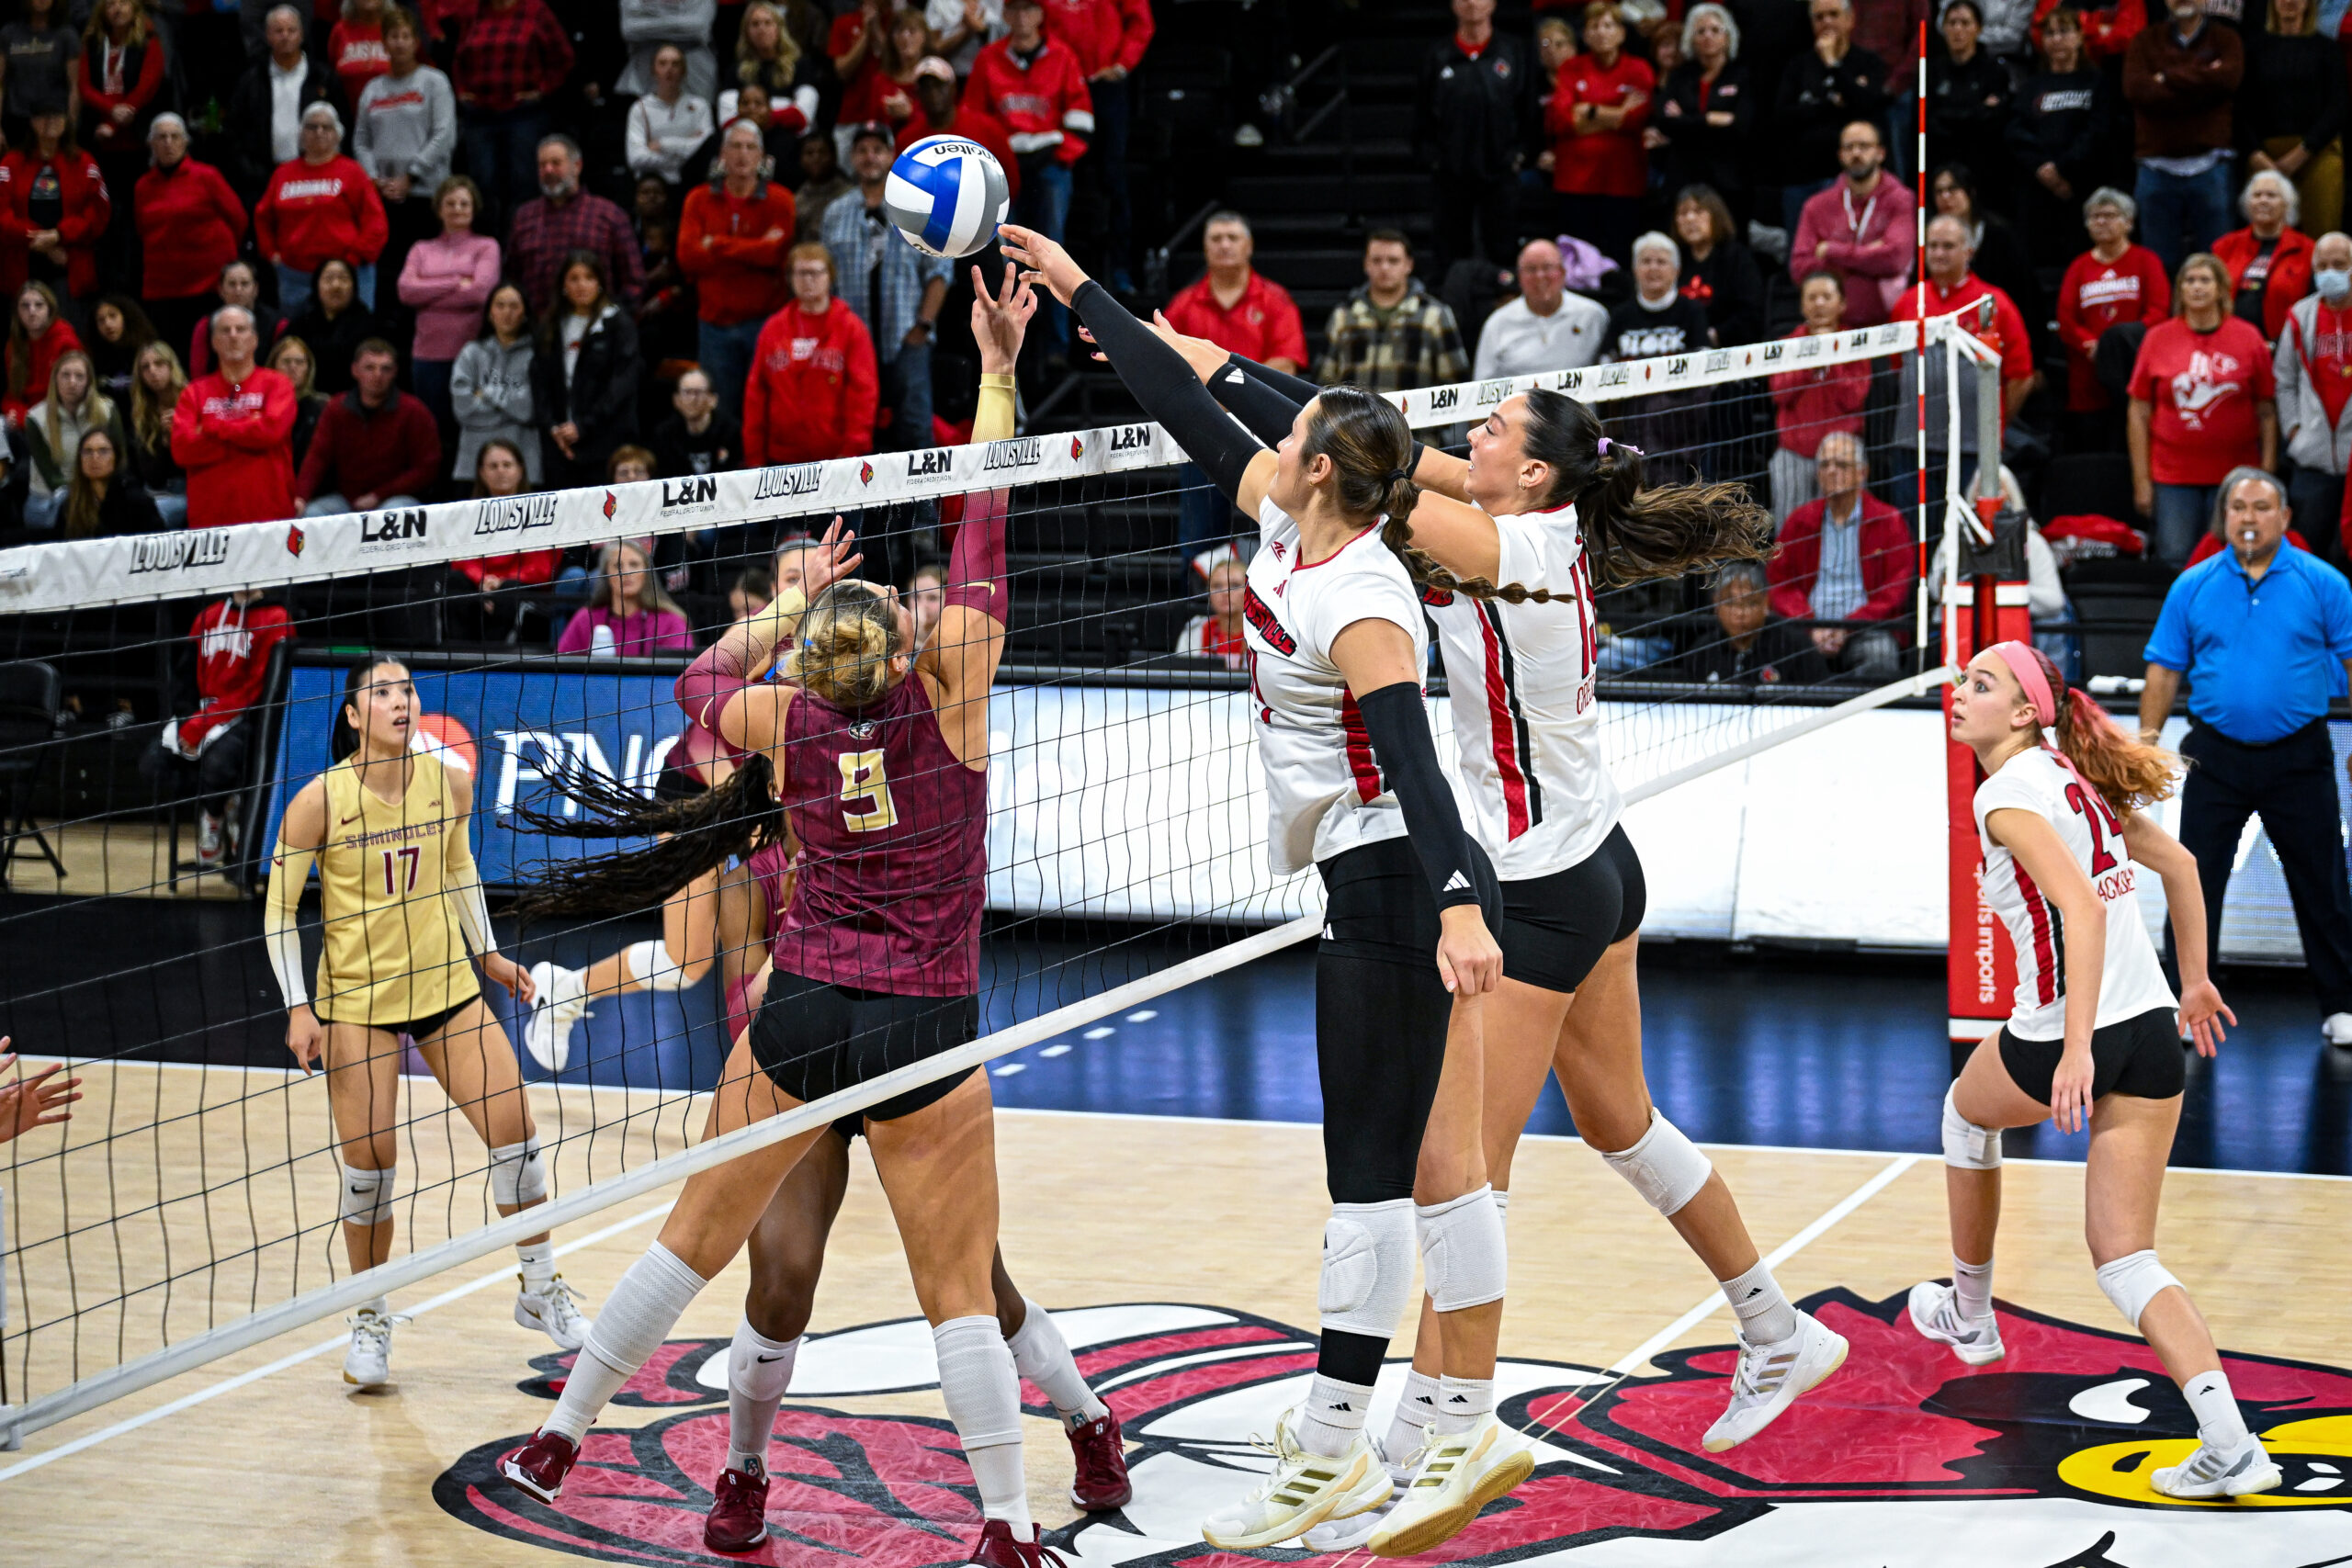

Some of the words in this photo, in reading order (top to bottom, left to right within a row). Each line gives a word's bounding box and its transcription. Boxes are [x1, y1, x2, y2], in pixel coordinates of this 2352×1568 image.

[934, 144, 996, 164] molten
[1557, 371, 1582, 390] L&N
[1430, 388, 1458, 410] L&N
[983, 437, 1041, 471] LOUISVILLE
[1111, 424, 1151, 451] L&N
[908, 448, 953, 477] L&N
[662, 475, 718, 508] L&N
[754, 462, 823, 500] LOUISVILLE
[360, 508, 427, 544] L&N
[474, 492, 559, 535] LOUISVILLE
[129, 528, 230, 575] LOUISVILLE
[838, 748, 899, 833] 9
[345, 818, 447, 850] SEMINOLES
[379, 844, 422, 896] 17
[1974, 927, 1997, 1004] imports
